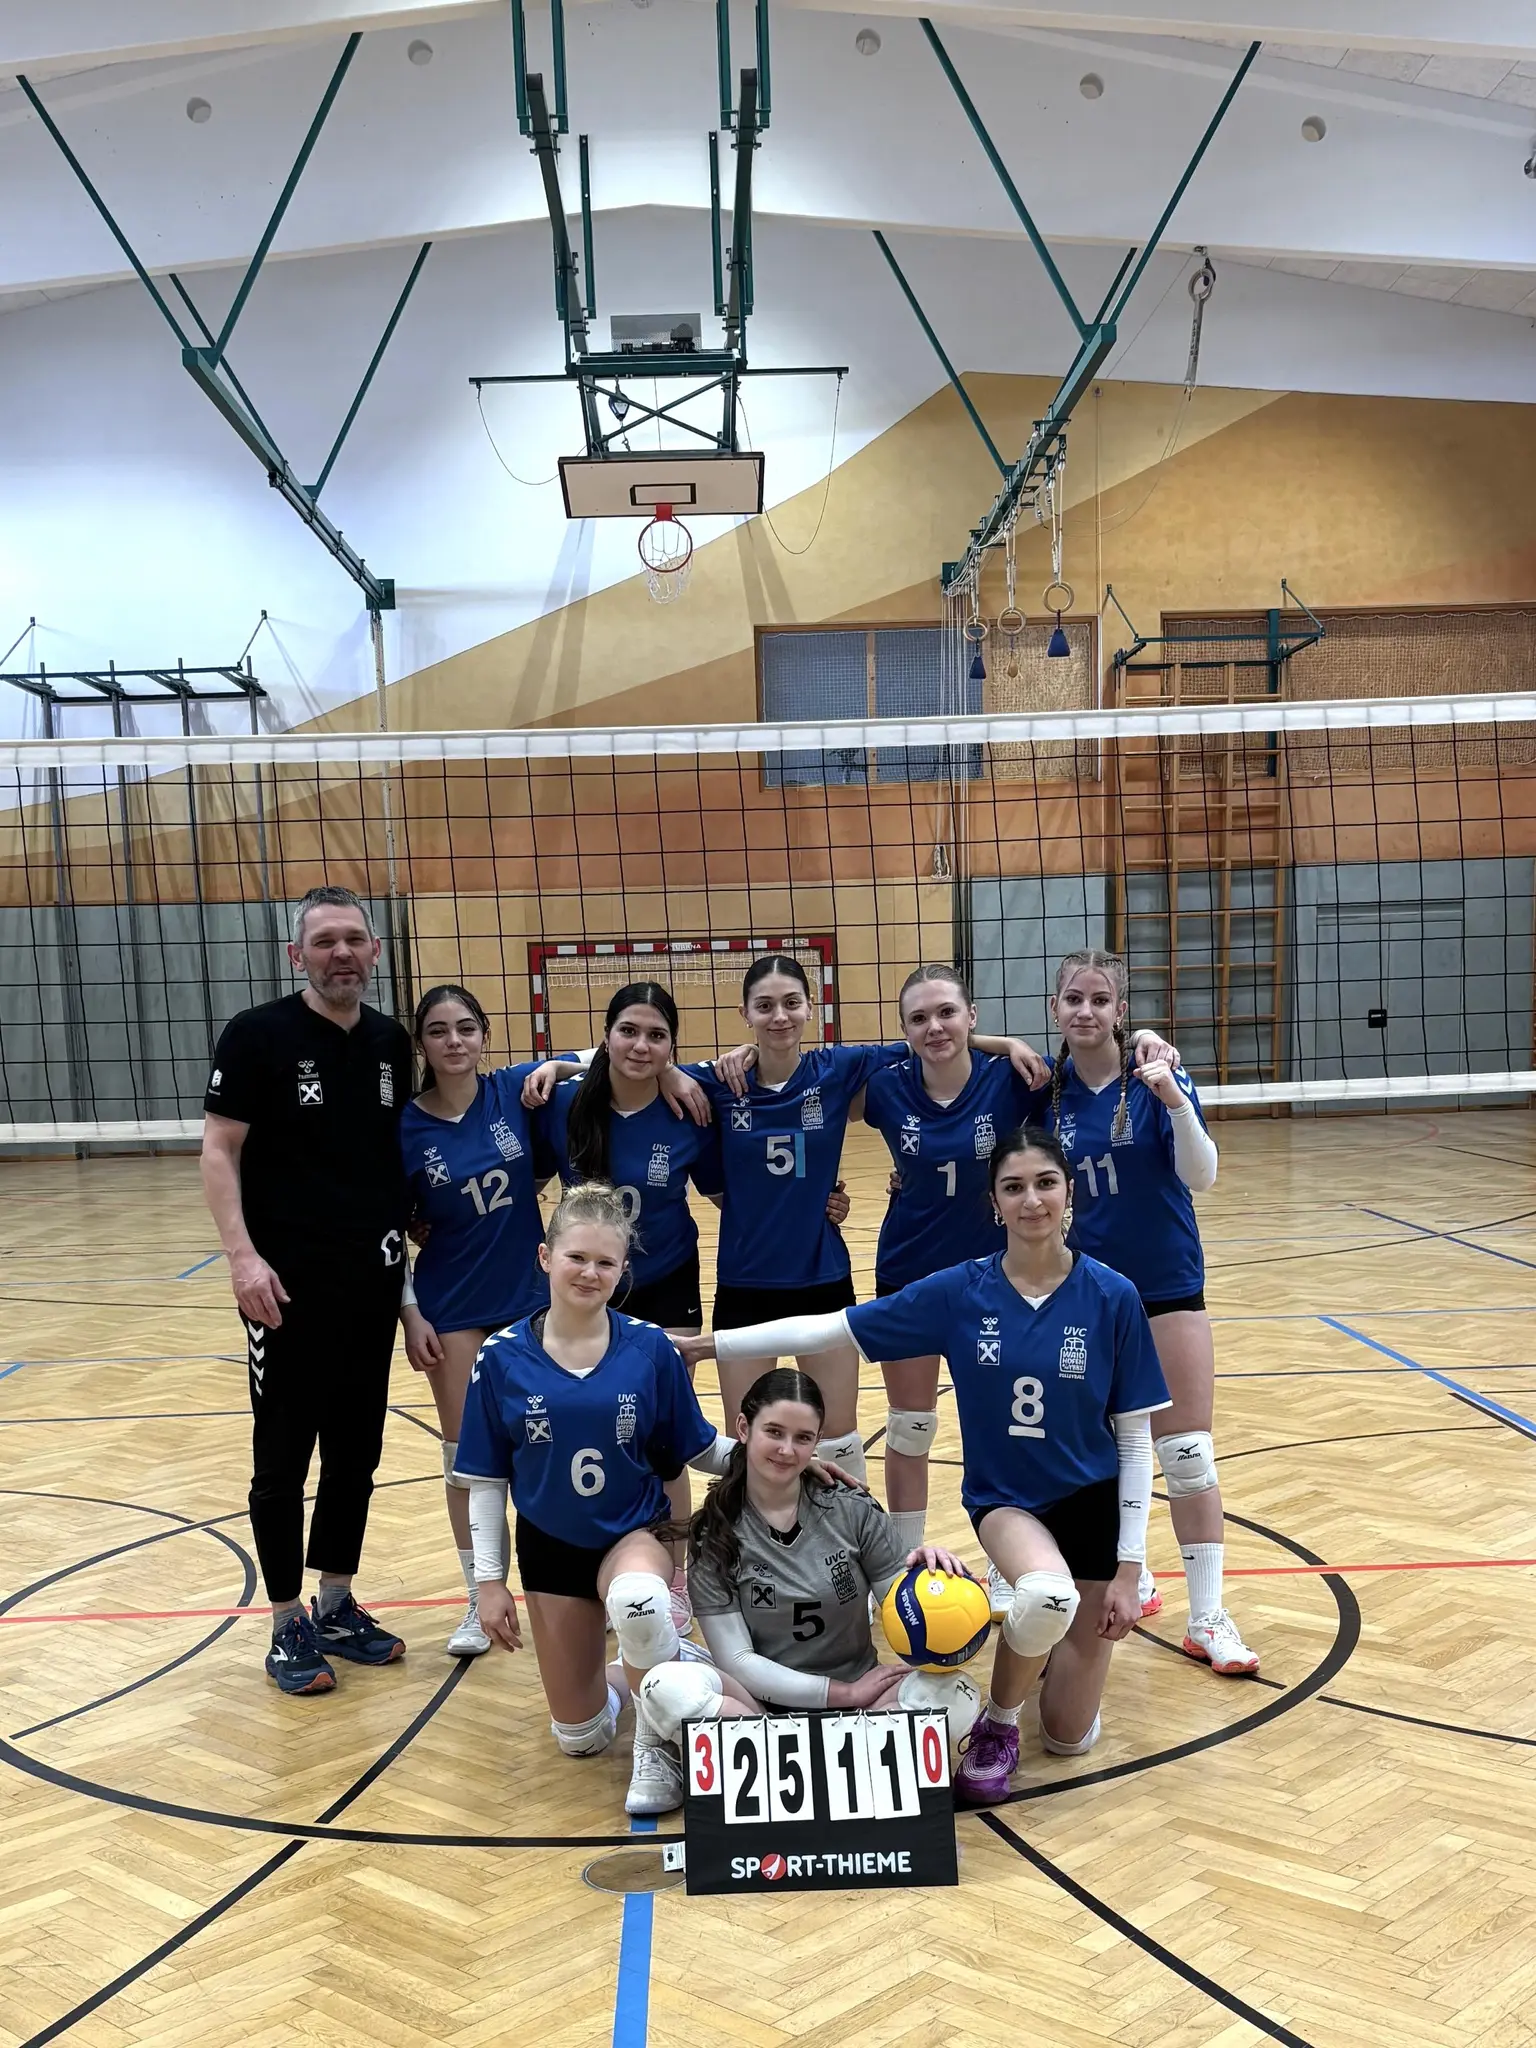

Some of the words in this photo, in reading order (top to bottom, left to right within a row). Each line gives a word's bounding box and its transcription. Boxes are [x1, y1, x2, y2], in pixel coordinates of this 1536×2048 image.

[379, 1061, 393, 1072] UVC
[802, 1086, 821, 1097] UVC
[1113, 1101, 1131, 1112] UC
[489, 1116, 506, 1132] UVC
[974, 1113, 993, 1124] UVC
[652, 1143, 671, 1153] UVC
[937, 1161, 956, 1197] 1
[1077, 1153, 1119, 1197] 11
[460, 1169, 513, 1215] 12
[1063, 1326, 1087, 1337] UVC
[1062, 1350, 1085, 1359] WAID
[617, 1393, 637, 1403] UVC
[1011, 1376, 1044, 1425] 8
[570, 1448, 606, 1497] 6
[824, 1550, 846, 1566] UVC
[792, 1600, 825, 1642] 5
[694, 1733, 715, 1792] 3
[922, 1725, 942, 1784] 0
[730, 1850, 912, 1881] SPORT-THIEME
